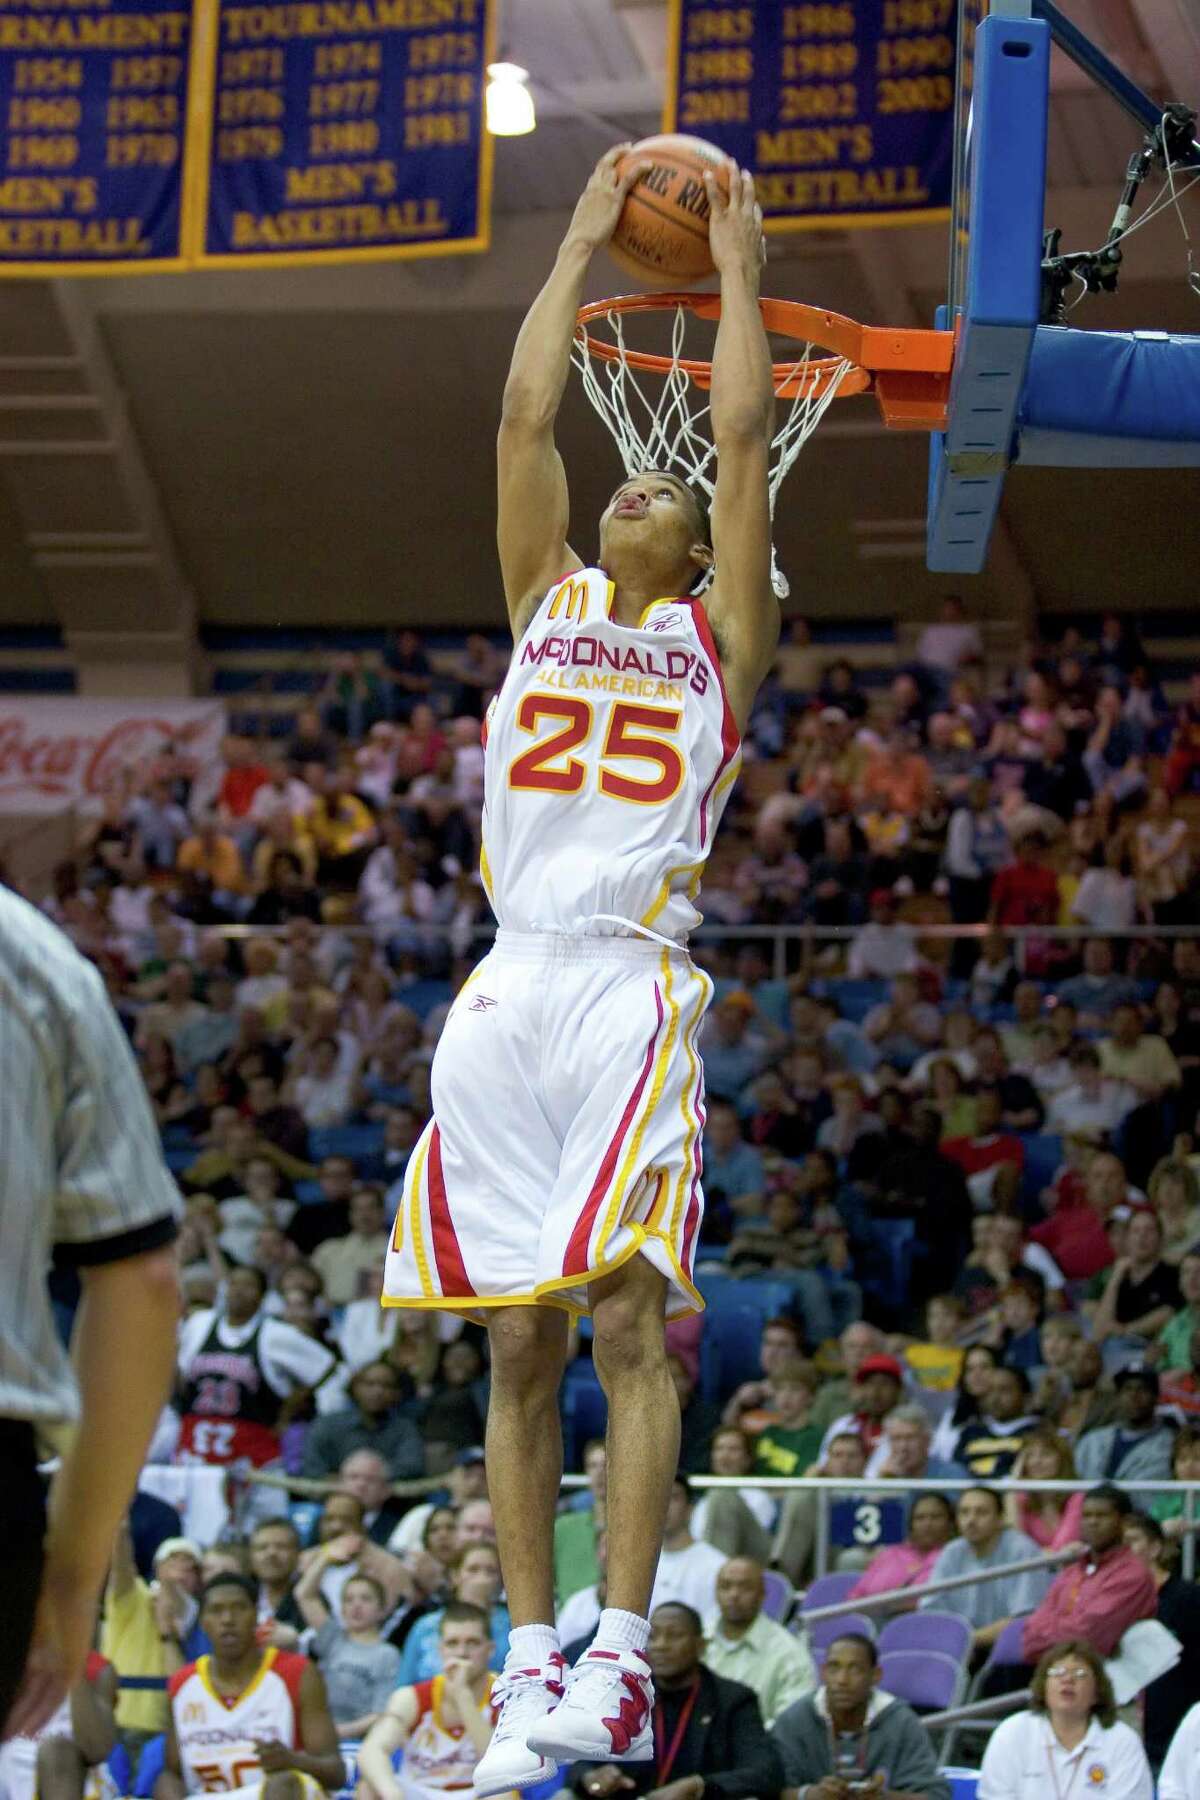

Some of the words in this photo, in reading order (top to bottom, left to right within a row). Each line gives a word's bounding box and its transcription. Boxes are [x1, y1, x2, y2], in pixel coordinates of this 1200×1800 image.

[225, 0, 475, 41] TOURNAMENT
[314, 41, 380, 75] 1974
[309, 80, 379, 117] 1977
[757, 126, 872, 164] MEN'S
[286, 162, 396, 200] MEN'S
[233, 200, 446, 247] BASKETBALL
[537, 670, 570, 690] ALL
[575, 672, 683, 702] AMERICAN
[508, 691, 686, 806] 25
[852, 1503, 882, 1543] 3
